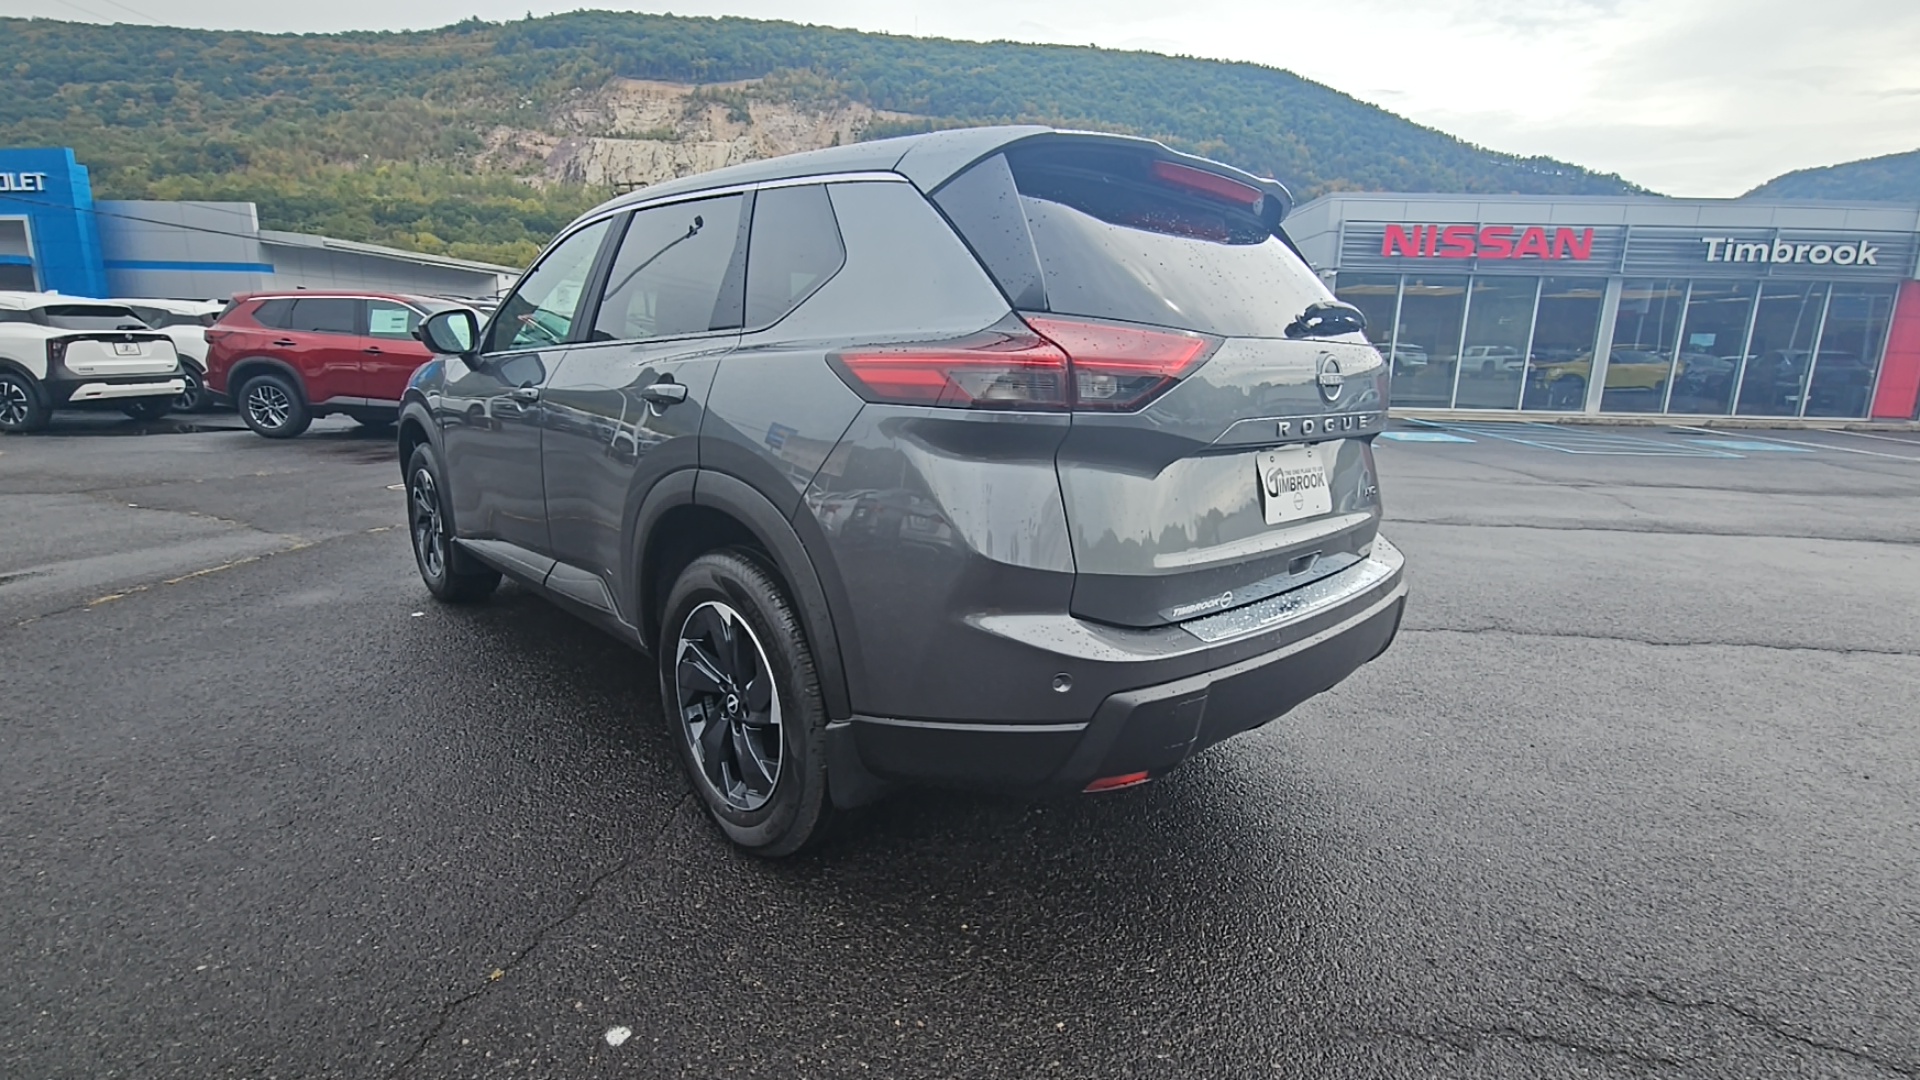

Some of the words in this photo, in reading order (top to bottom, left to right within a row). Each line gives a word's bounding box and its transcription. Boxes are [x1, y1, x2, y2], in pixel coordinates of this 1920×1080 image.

[1381, 224, 1594, 260] NISSAN
[1701, 237, 1879, 265] Timbrook
[1276, 415, 1368, 437] ROGUE
